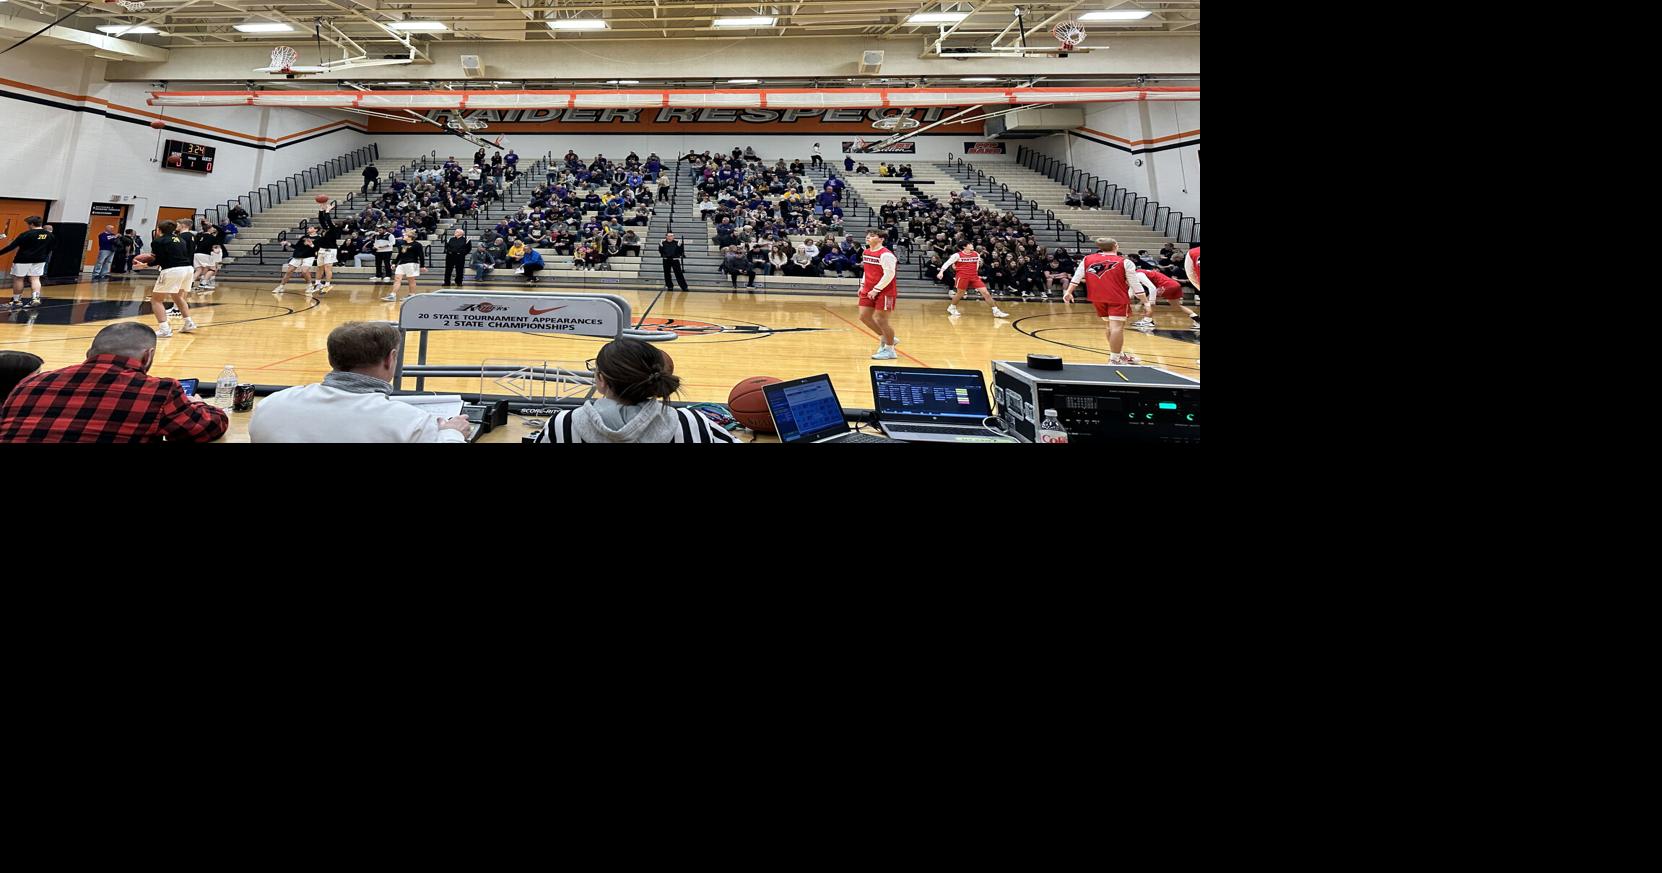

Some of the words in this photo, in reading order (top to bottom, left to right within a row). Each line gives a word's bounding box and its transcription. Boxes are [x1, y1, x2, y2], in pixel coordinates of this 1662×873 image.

[425, 107, 641, 123] RAIDER
[533, 317, 603, 325] APPEARANCES
[488, 322, 575, 331] CHAMPIONSHIPS
